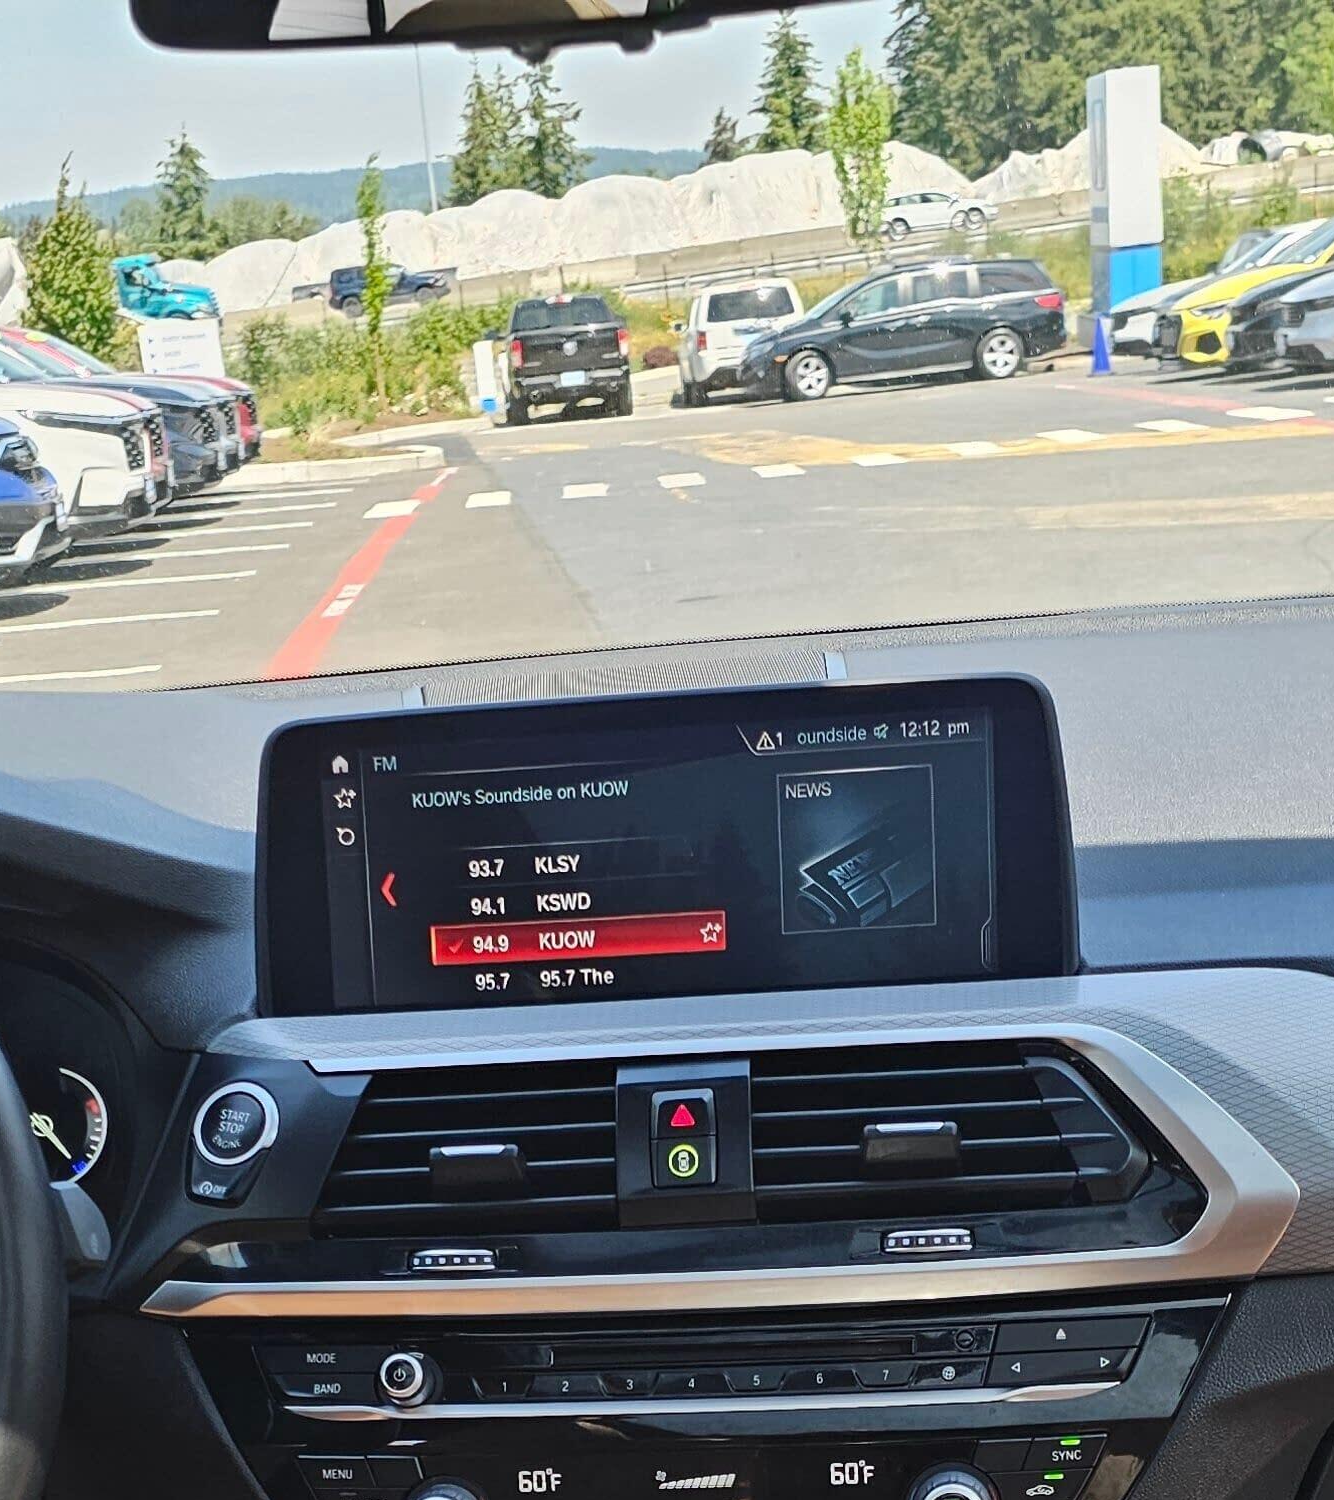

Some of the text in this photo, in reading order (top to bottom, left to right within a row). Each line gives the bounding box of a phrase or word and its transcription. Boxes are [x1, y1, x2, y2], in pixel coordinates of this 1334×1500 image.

[797, 725, 867, 745] oundside
[899, 720, 940, 738] 12:12
[947, 722, 970, 738] pm
[373, 756, 397, 772] FM
[412, 780, 628, 808] KUOW's Soundside on KUOW
[785, 782, 832, 799] NEWS
[468, 854, 581, 878] 93.7 KLSY
[470, 892, 591, 915] 94.1 KSWD
[473, 930, 595, 953] 94.9 KUOW
[475, 967, 615, 990] 95.7 95.7 The
[220, 1109, 250, 1122] START
[219, 1121, 244, 1134] STOP
[212, 1134, 242, 1149] ENGINE
[213, 1184, 227, 1194] OFF
[306, 1352, 336, 1364] MODE
[313, 1383, 342, 1395] BAND
[502, 1369, 890, 1392] 1 2 3 4 5 6 7
[1051, 1449, 1082, 1462] SYNC
[322, 1469, 353, 1480] MENU
[518, 1468, 562, 1493] 60°F
[829, 1460, 874, 1485] 60°F
